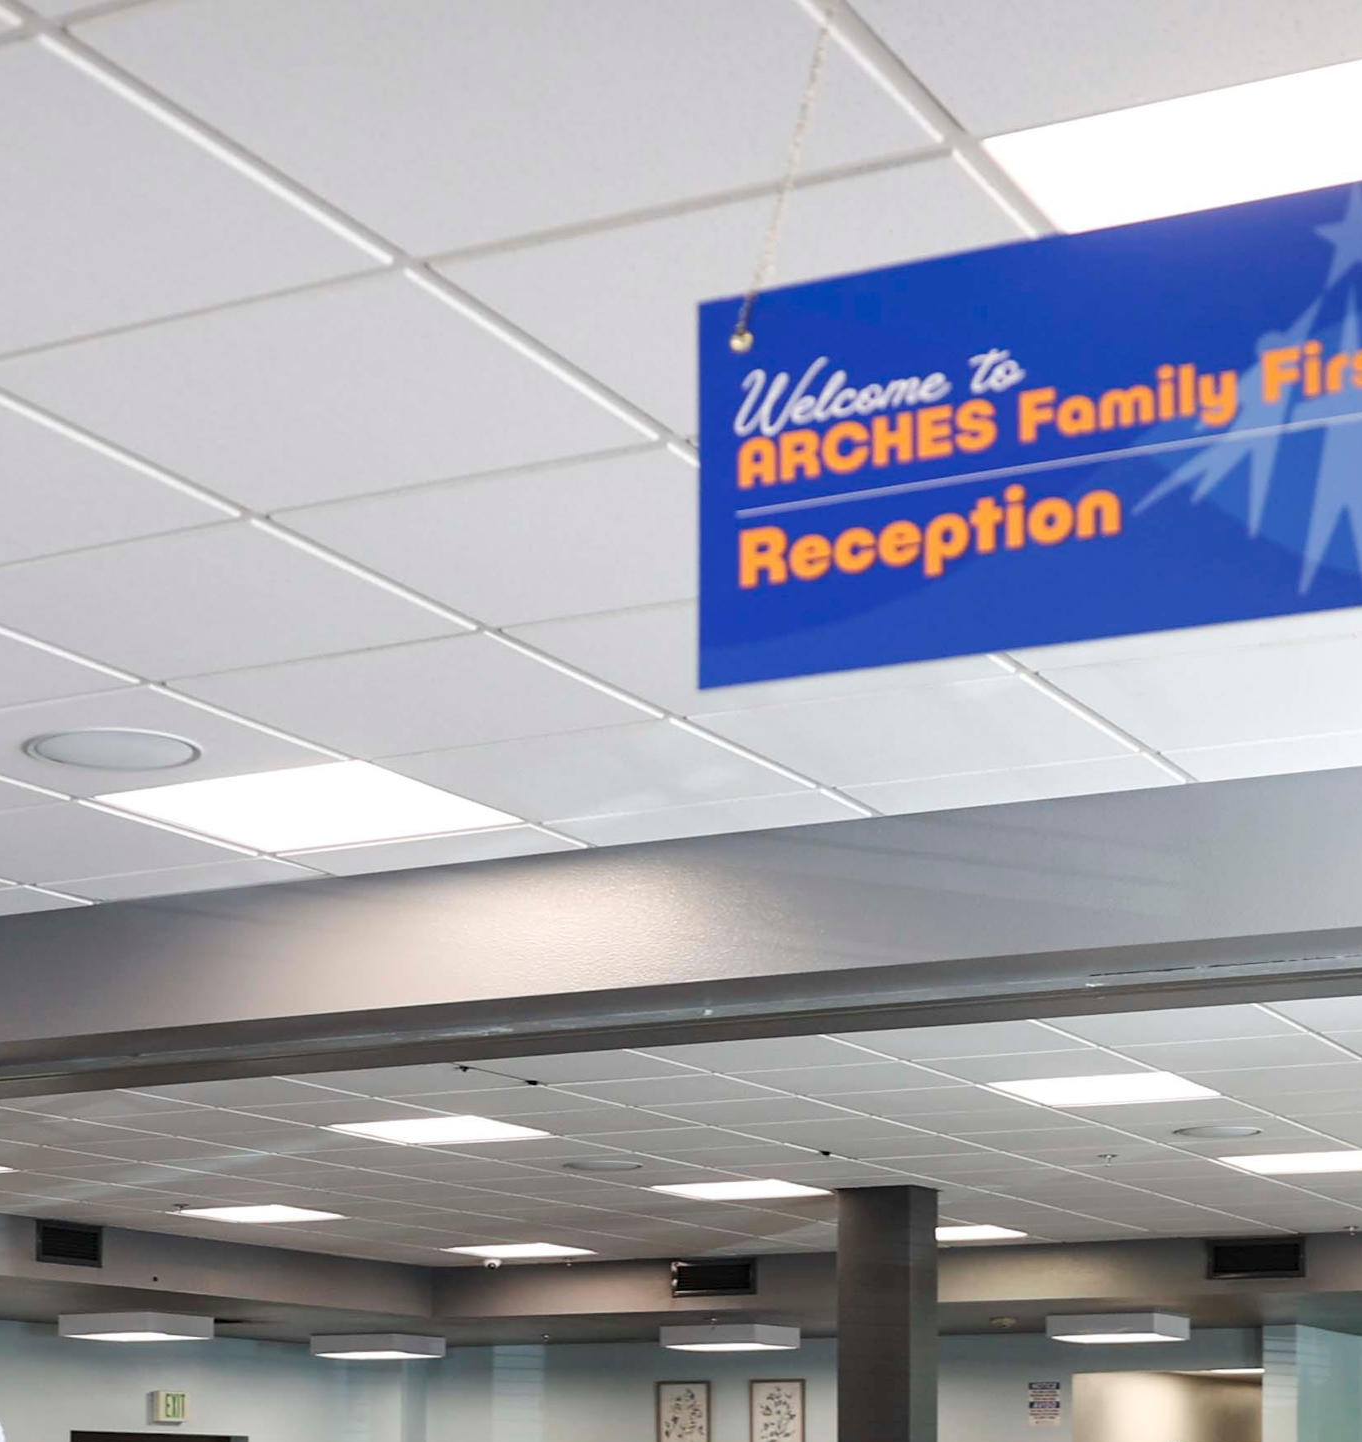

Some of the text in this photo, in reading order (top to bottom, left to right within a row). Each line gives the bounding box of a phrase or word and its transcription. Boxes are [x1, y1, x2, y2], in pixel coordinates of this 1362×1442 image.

[733, 348, 1027, 436] Welcome to
[737, 399, 998, 490] ARCHES
[1018, 363, 1239, 444] Family
[738, 484, 1122, 588] Reception
[165, 1393, 186, 1418] EXIT
